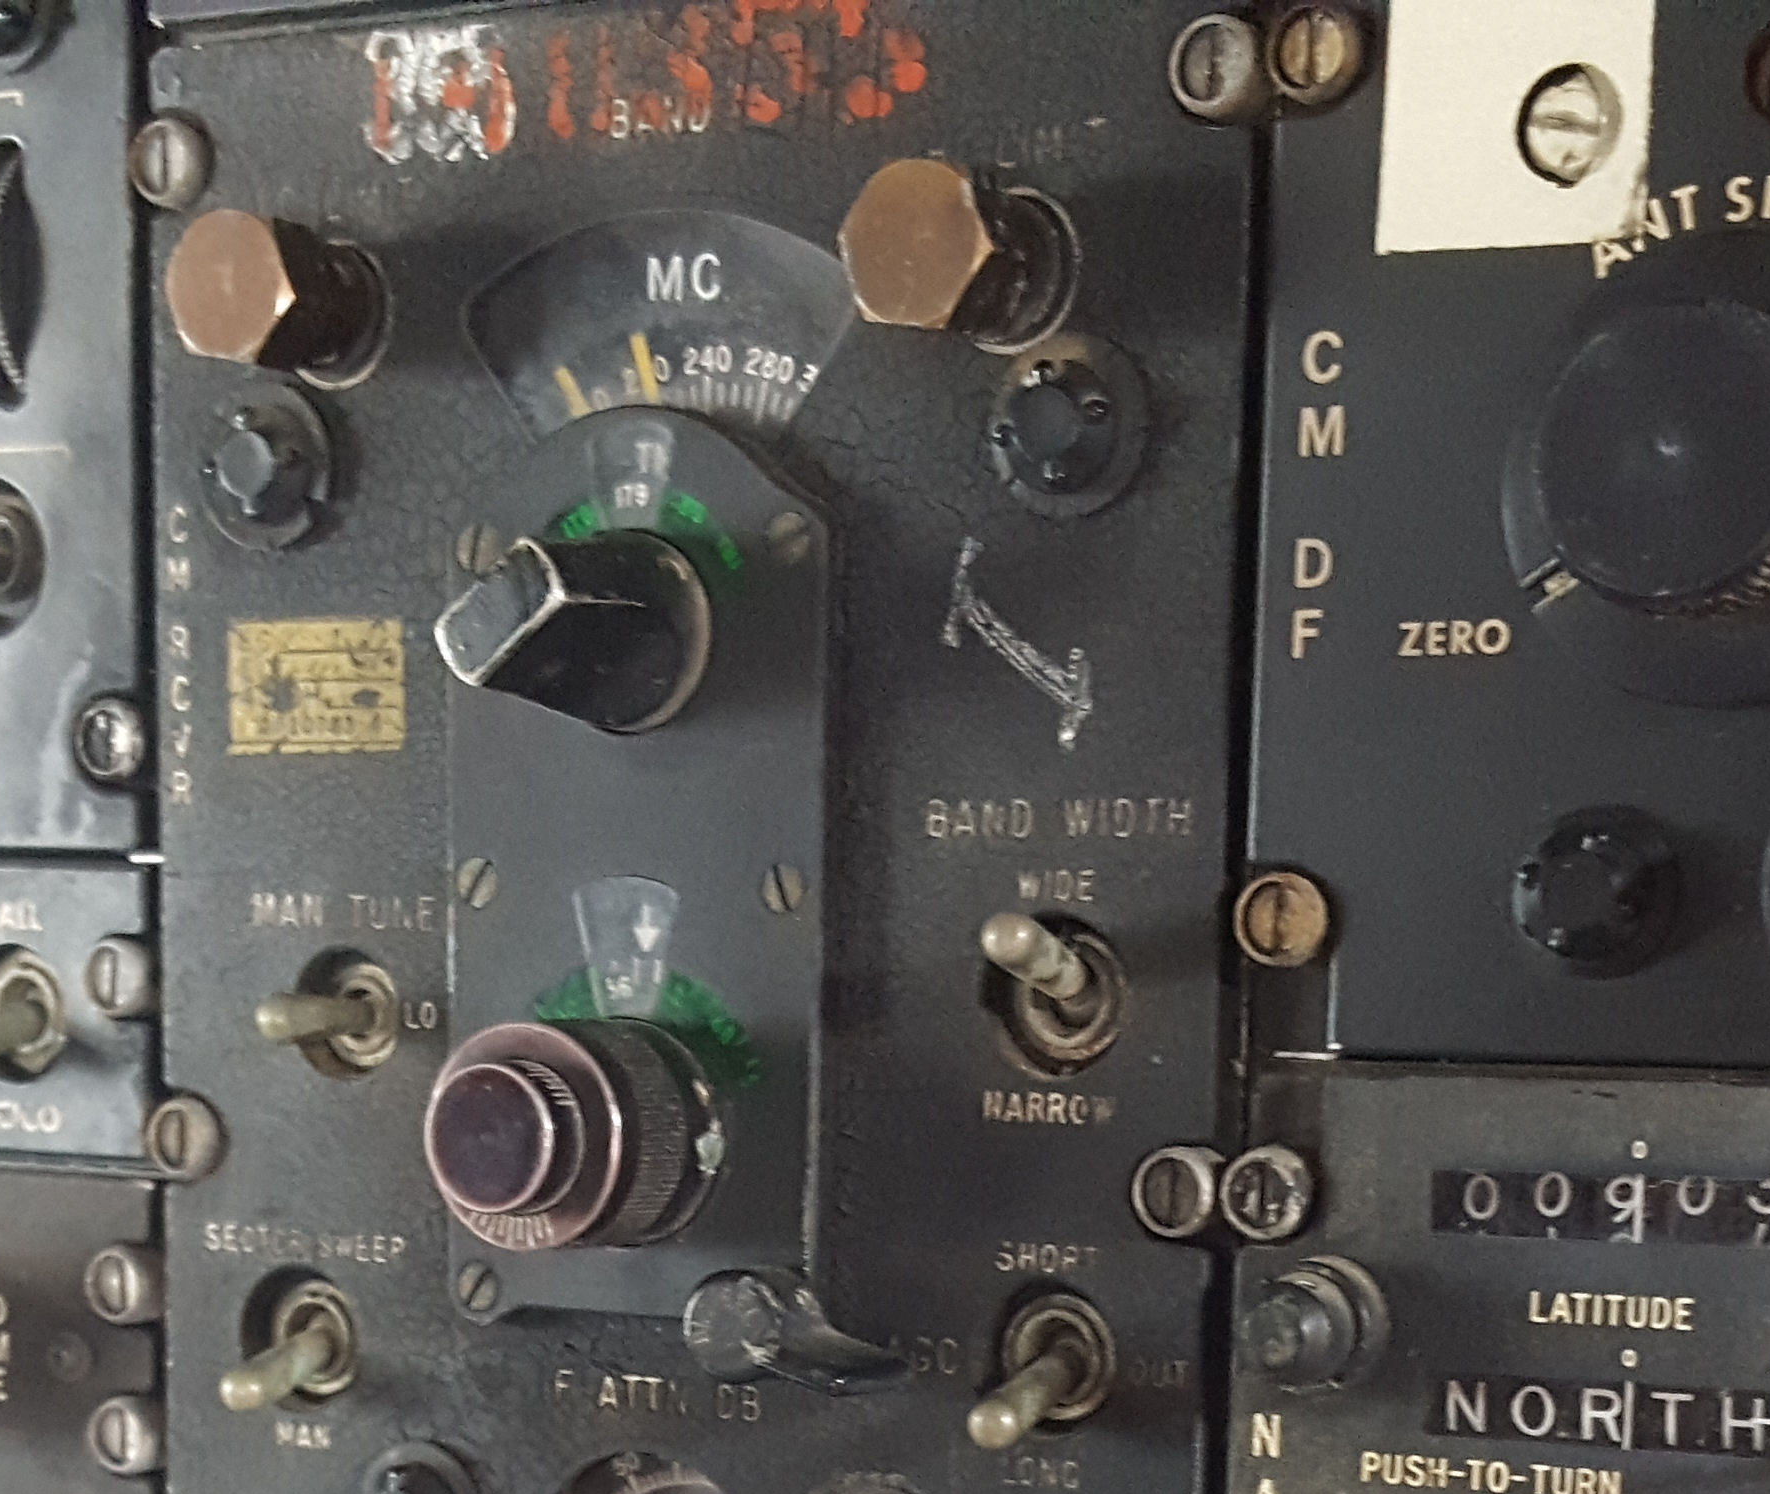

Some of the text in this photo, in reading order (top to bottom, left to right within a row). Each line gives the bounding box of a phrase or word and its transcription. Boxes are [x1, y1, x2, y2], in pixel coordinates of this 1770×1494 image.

[1592, 184, 1699, 280] ANT
[647, 253, 721, 304] MC
[683, 345, 733, 376] 240
[744, 348, 796, 384] 280
[1398, 617, 1512, 659] ZERO
[927, 800, 1194, 840] BAND WIDTH
[1018, 868, 1096, 905] WIDE
[250, 891, 323, 930] MAN
[982, 1088, 1114, 1127] NARROW
[994, 1239, 1102, 1275] SHORT
[1528, 1290, 1696, 1334] LATITUDE
[274, 1419, 333, 1454] MAN
